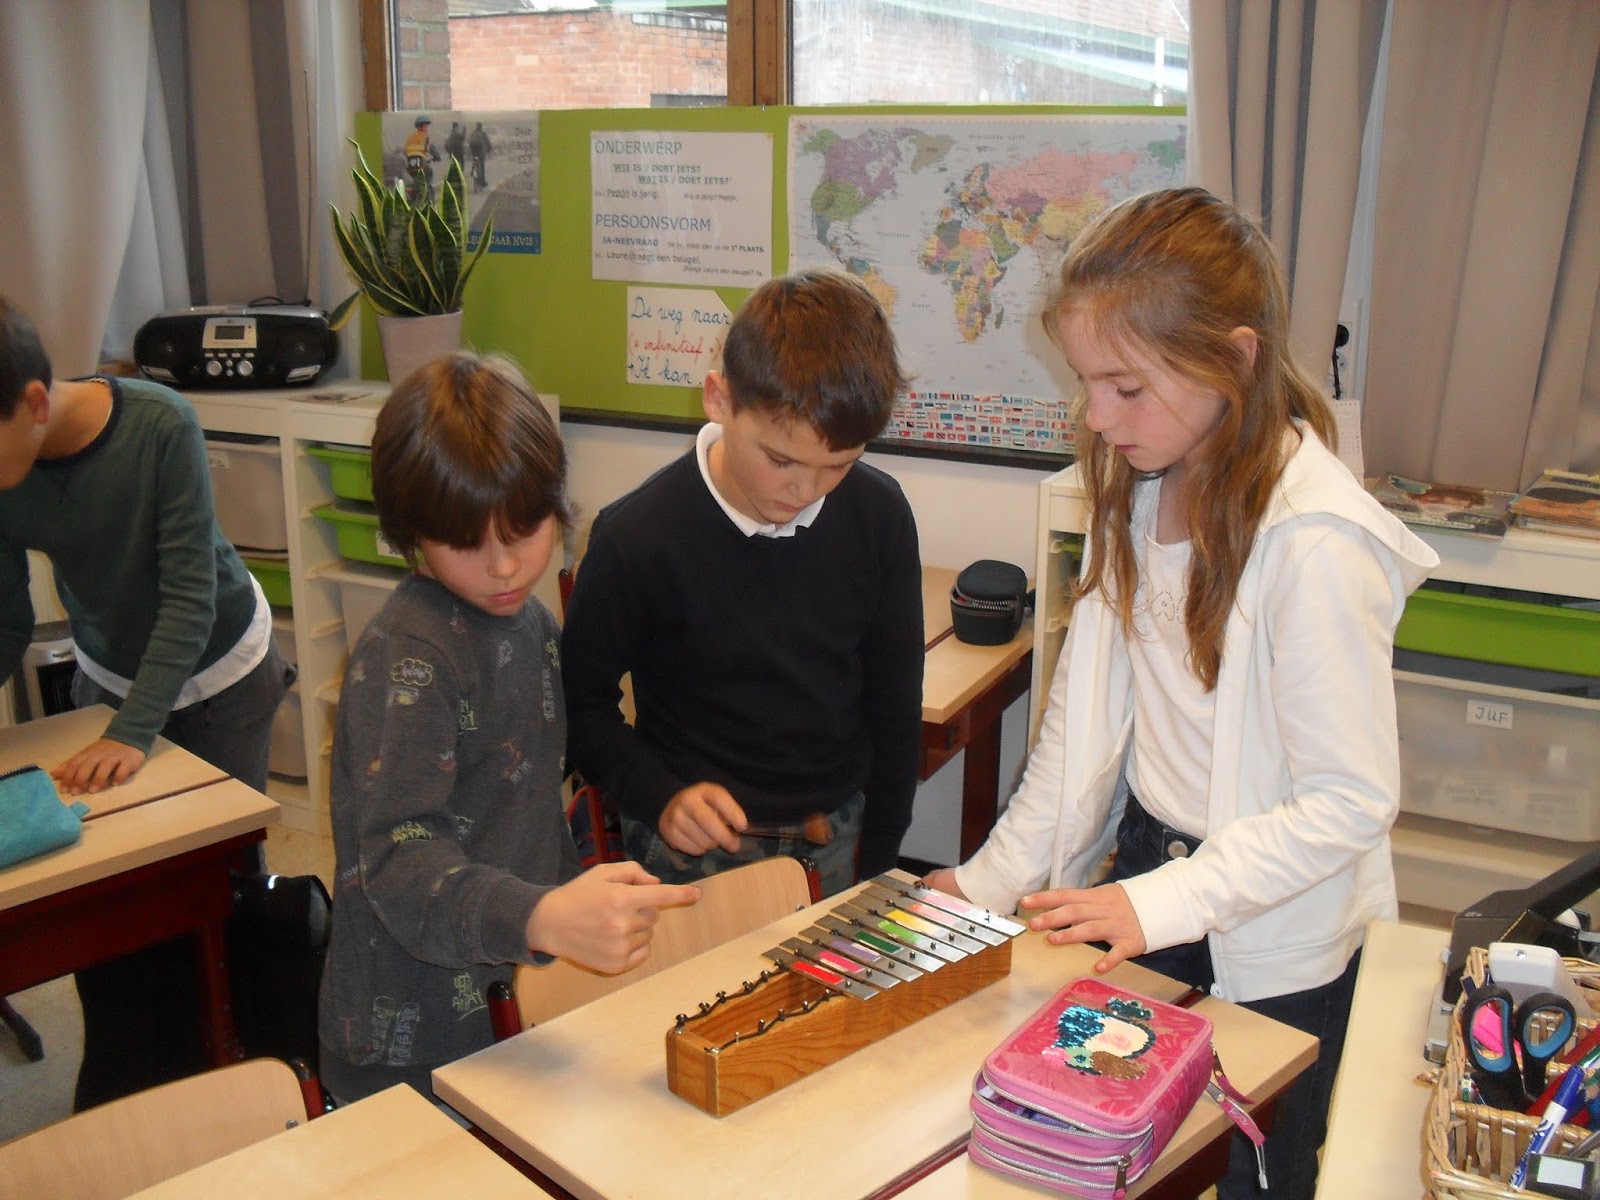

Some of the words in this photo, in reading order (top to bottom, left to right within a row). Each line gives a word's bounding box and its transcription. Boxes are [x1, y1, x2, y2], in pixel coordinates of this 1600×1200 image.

[595, 140, 682, 155] ONDERWERP
[613, 163, 631, 172] WIE
[632, 163, 642, 172] IS
[652, 165, 674, 173] DOET
[638, 175, 656, 184] WAT
[659, 175, 669, 183] IS
[595, 214, 711, 231] PERSOONSVORM
[602, 236, 658, 246] JA-NEEVRAAG
[631, 296, 651, 318] De
[658, 308, 684, 335] weg
[692, 309, 731, 325] naar
[658, 359, 692, 384] kan
[1475, 706, 1508, 724] JUF
